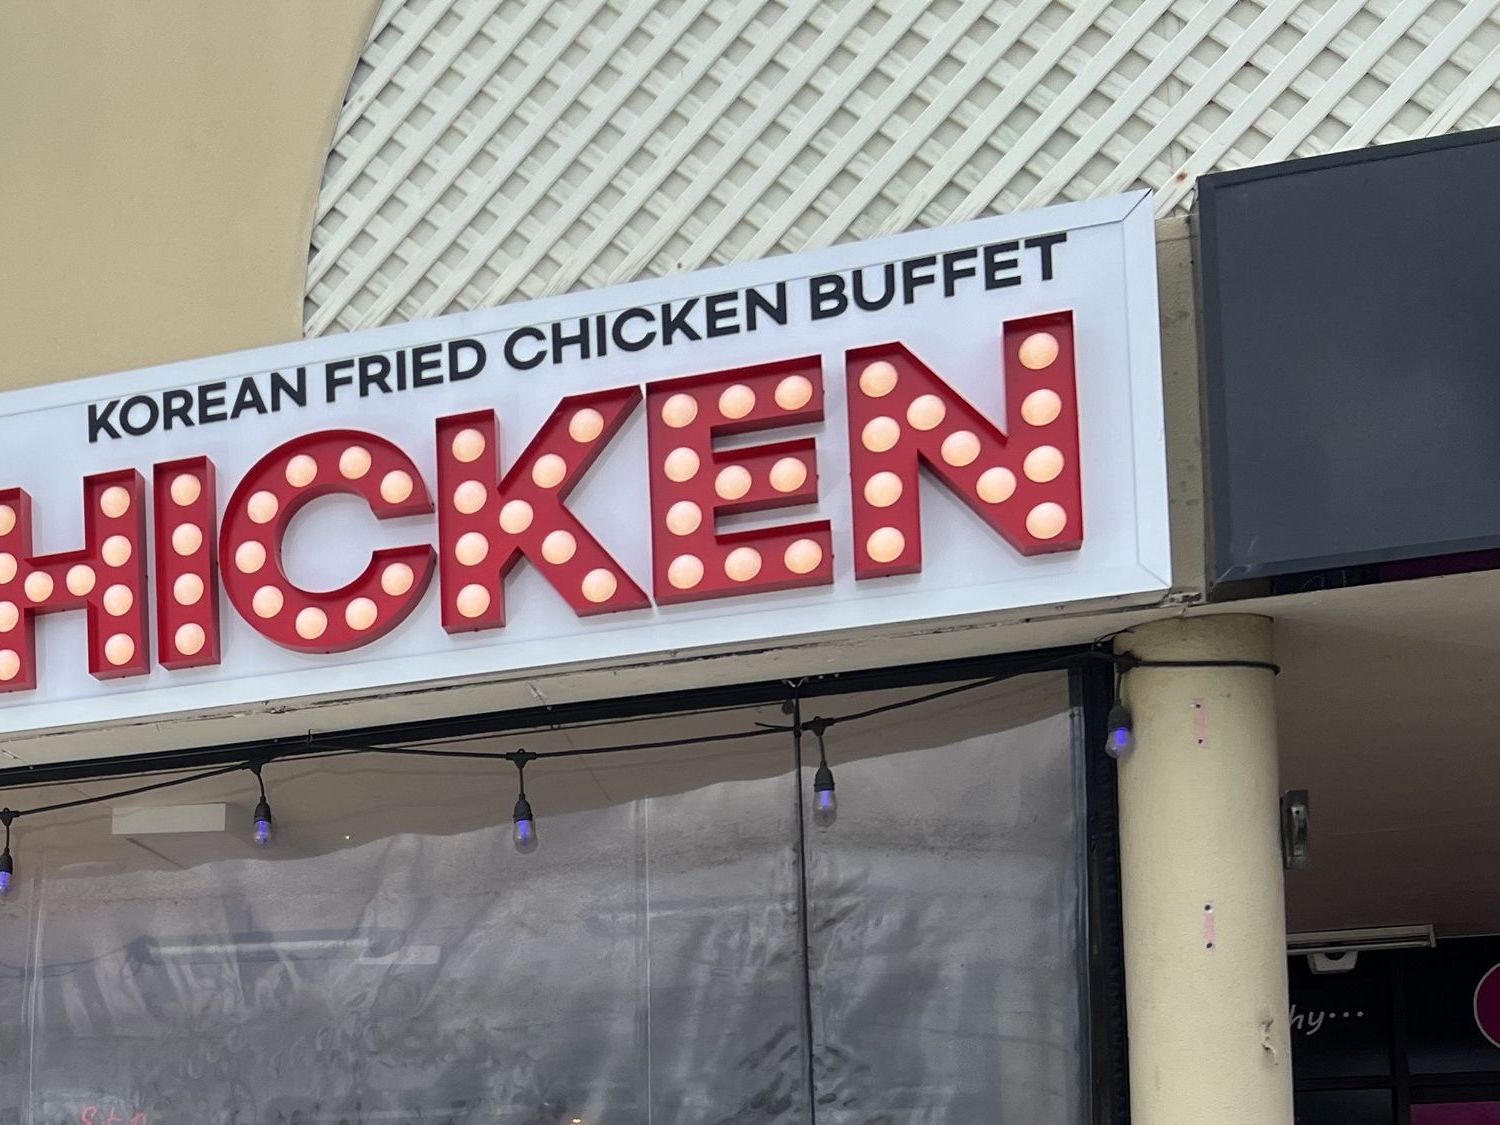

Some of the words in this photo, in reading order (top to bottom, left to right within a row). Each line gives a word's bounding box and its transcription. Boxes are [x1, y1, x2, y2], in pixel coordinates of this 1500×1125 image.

[87, 366, 307, 443] KOREAN
[325, 338, 487, 403] FRIED
[504, 281, 788, 371] CHICKEN
[809, 232, 1068, 321] BUFFET
